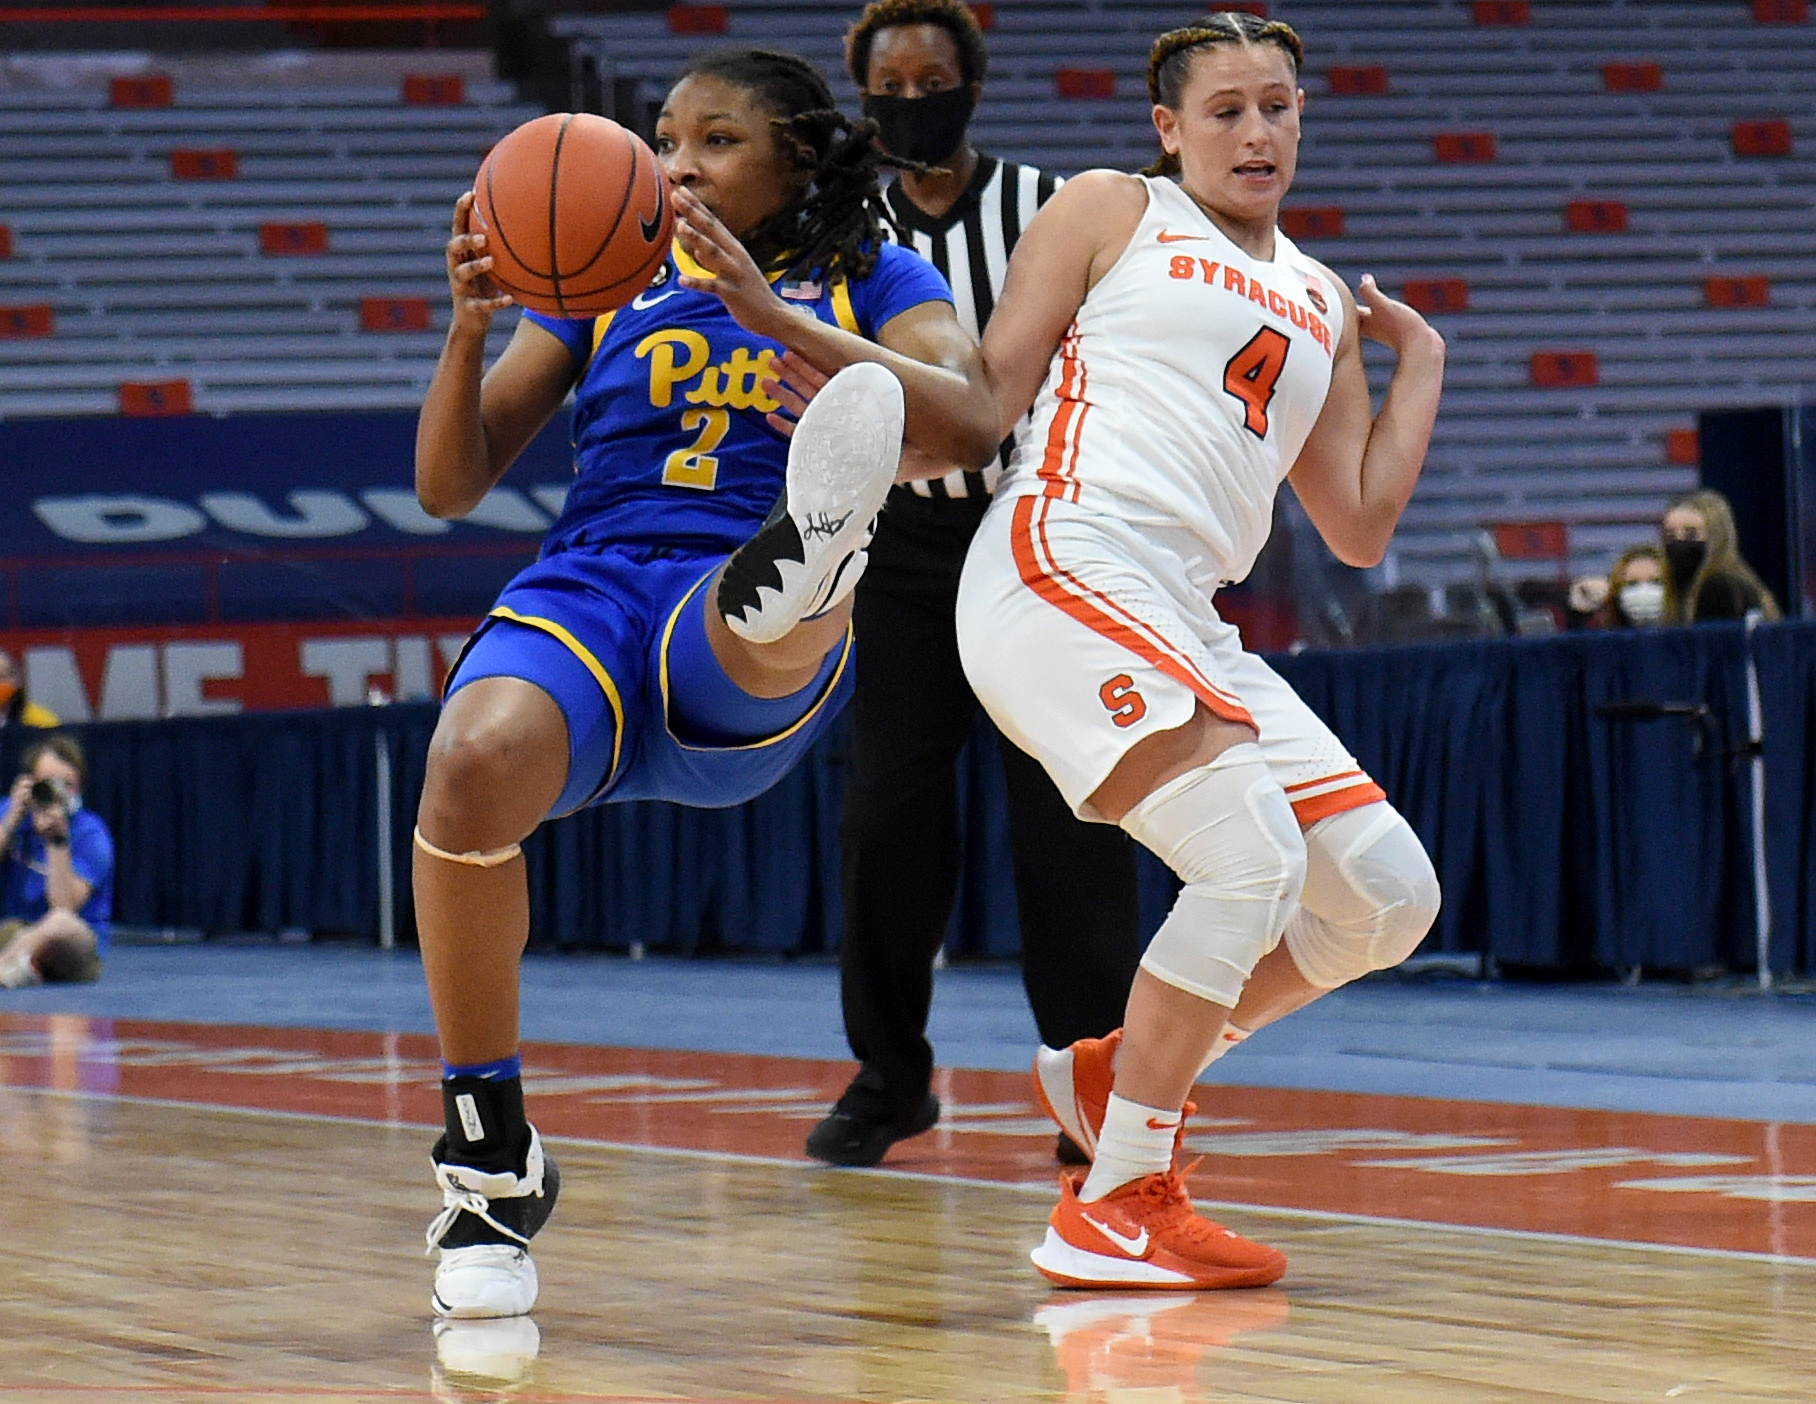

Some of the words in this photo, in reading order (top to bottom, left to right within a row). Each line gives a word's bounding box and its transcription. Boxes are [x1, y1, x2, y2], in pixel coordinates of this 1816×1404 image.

[1168, 254, 1333, 358] SYRACUSE
[634, 327, 783, 414] Pitt
[1222, 324, 1292, 441] 4
[660, 407, 731, 492] 2
[1098, 672, 1147, 728] S
